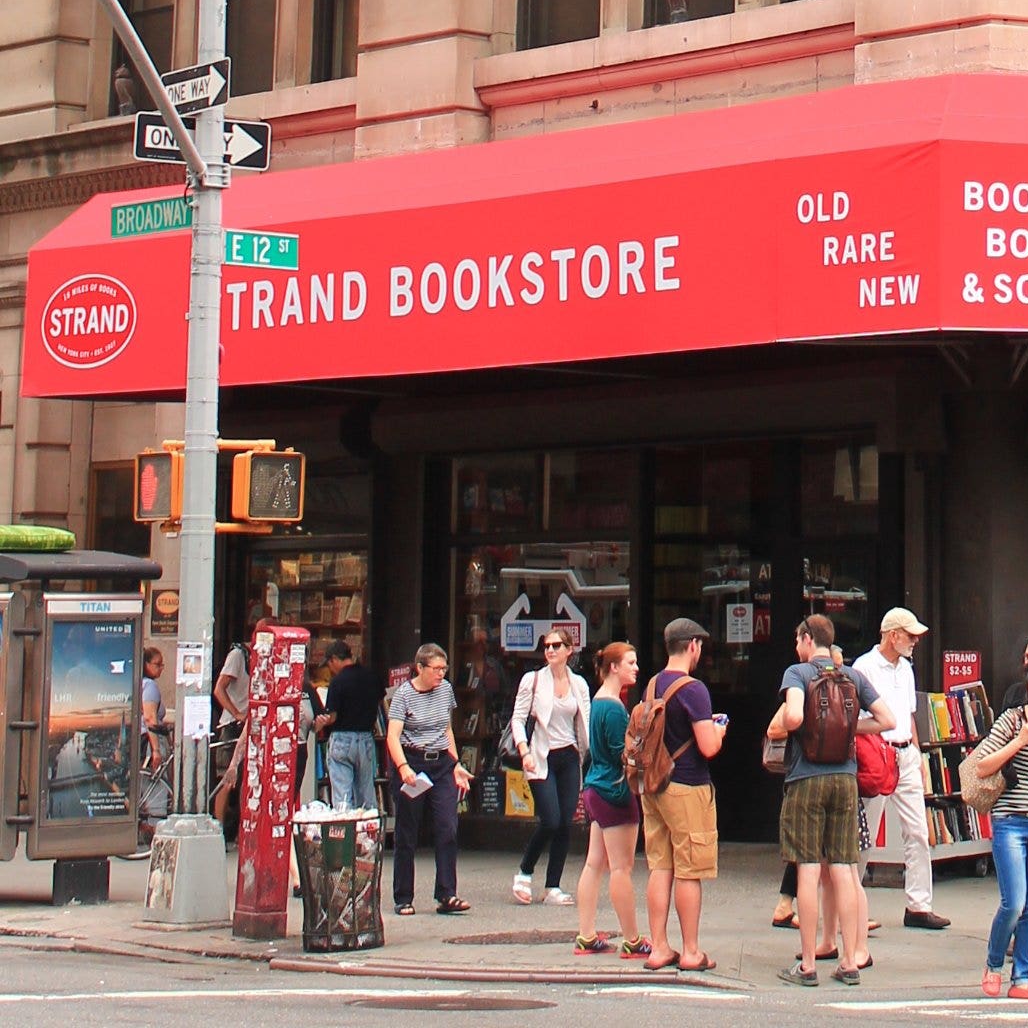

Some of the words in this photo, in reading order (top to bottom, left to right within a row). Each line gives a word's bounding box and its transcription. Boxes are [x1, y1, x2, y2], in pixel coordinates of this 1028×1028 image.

[168, 84, 186, 103] ONE
[191, 77, 211, 96] WAY
[150, 128, 180, 147] ON
[116, 198, 190, 234] BROADWAY
[797, 191, 850, 224] OLD
[232, 235, 243, 262] E
[253, 236, 270, 264] 12
[278, 239, 290, 254] ST
[823, 231, 895, 266] RARE
[186, 271, 367, 332] TRAND
[390, 235, 681, 318] BOOKSTORE
[859, 274, 920, 308] NEW
[962, 272, 985, 304] &
[50, 303, 129, 338] STRAND
[80, 602, 111, 612] TITAN
[95, 625, 123, 633] UNITED
[945, 653, 977, 663] STRAND
[949, 665, 972, 676] $2-$5
[96, 691, 130, 704] friendly
